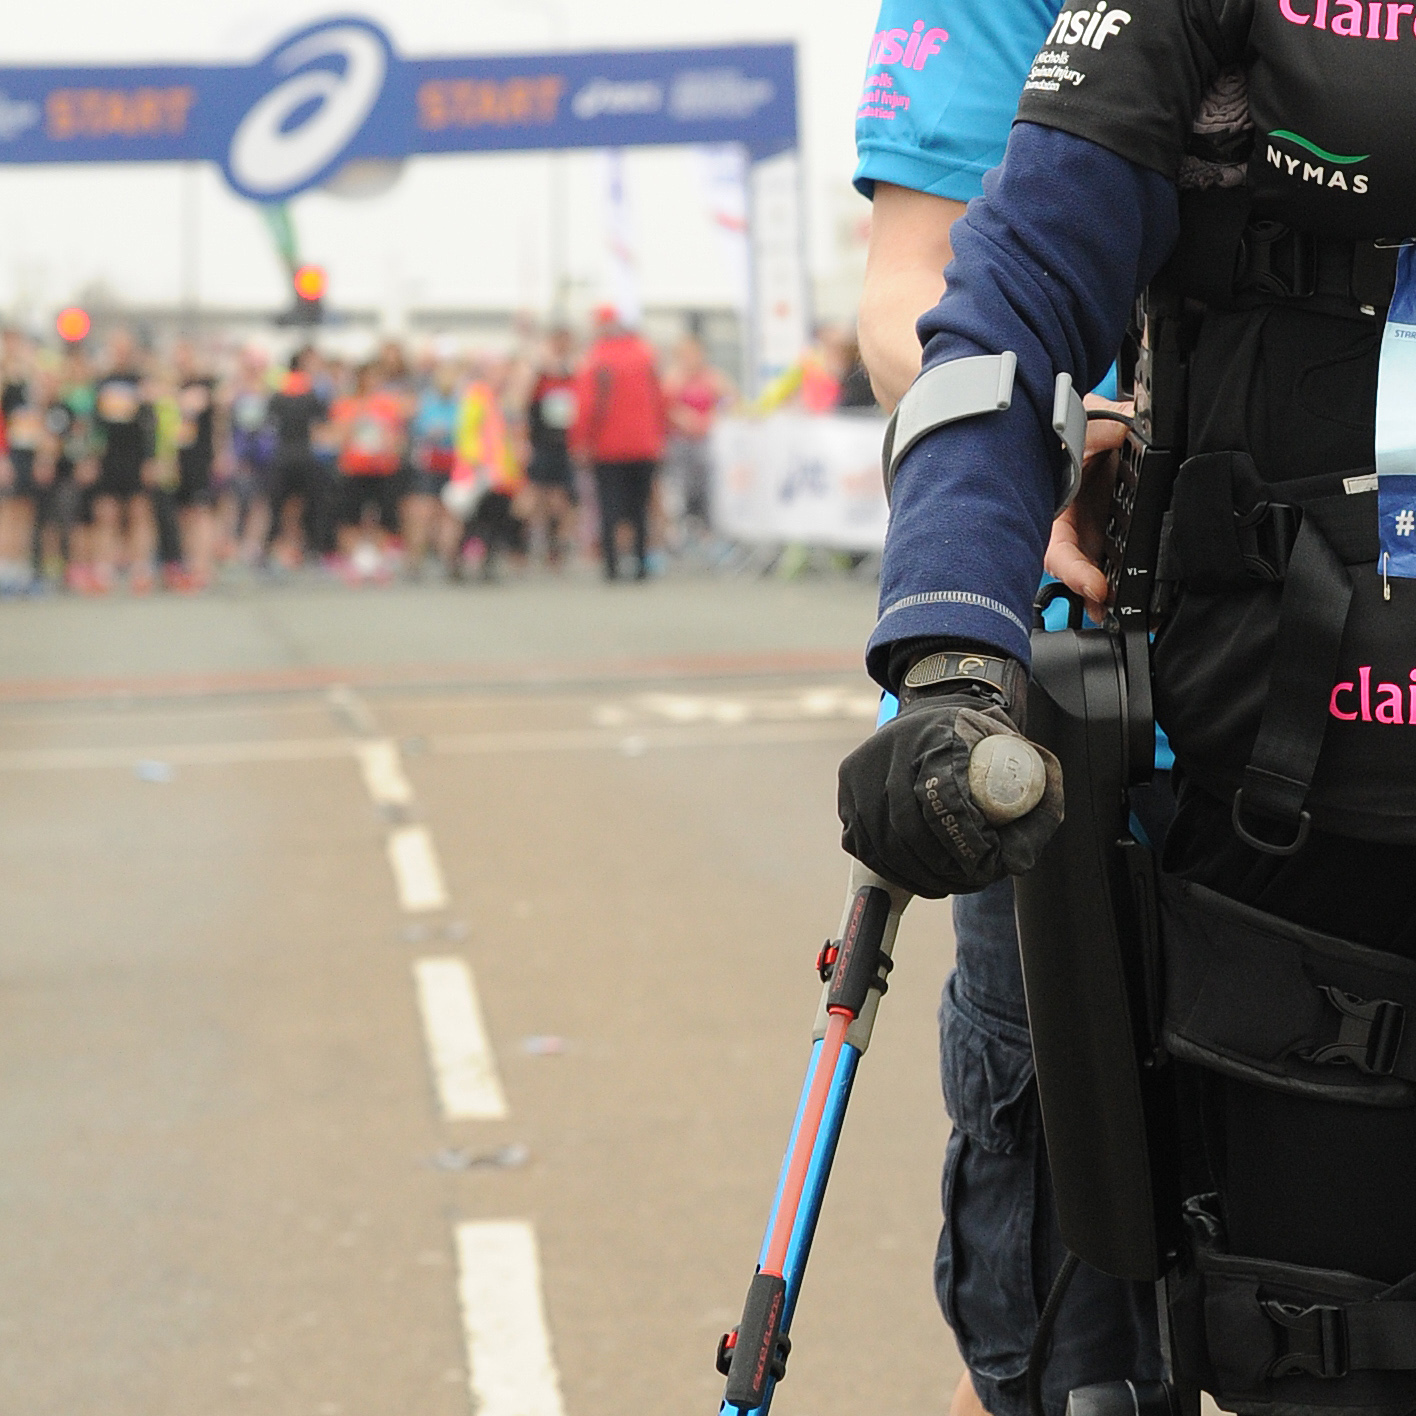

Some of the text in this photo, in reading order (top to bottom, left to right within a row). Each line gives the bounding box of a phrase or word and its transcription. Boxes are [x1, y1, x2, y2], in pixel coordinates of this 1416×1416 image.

[868, 19, 949, 70] nsif
[1045, 0, 1132, 51] nsif
[1054, 65, 1086, 86] Injury
[45, 86, 197, 141] START
[417, 75, 567, 131] START
[1266, 144, 1370, 195] NYMAS
